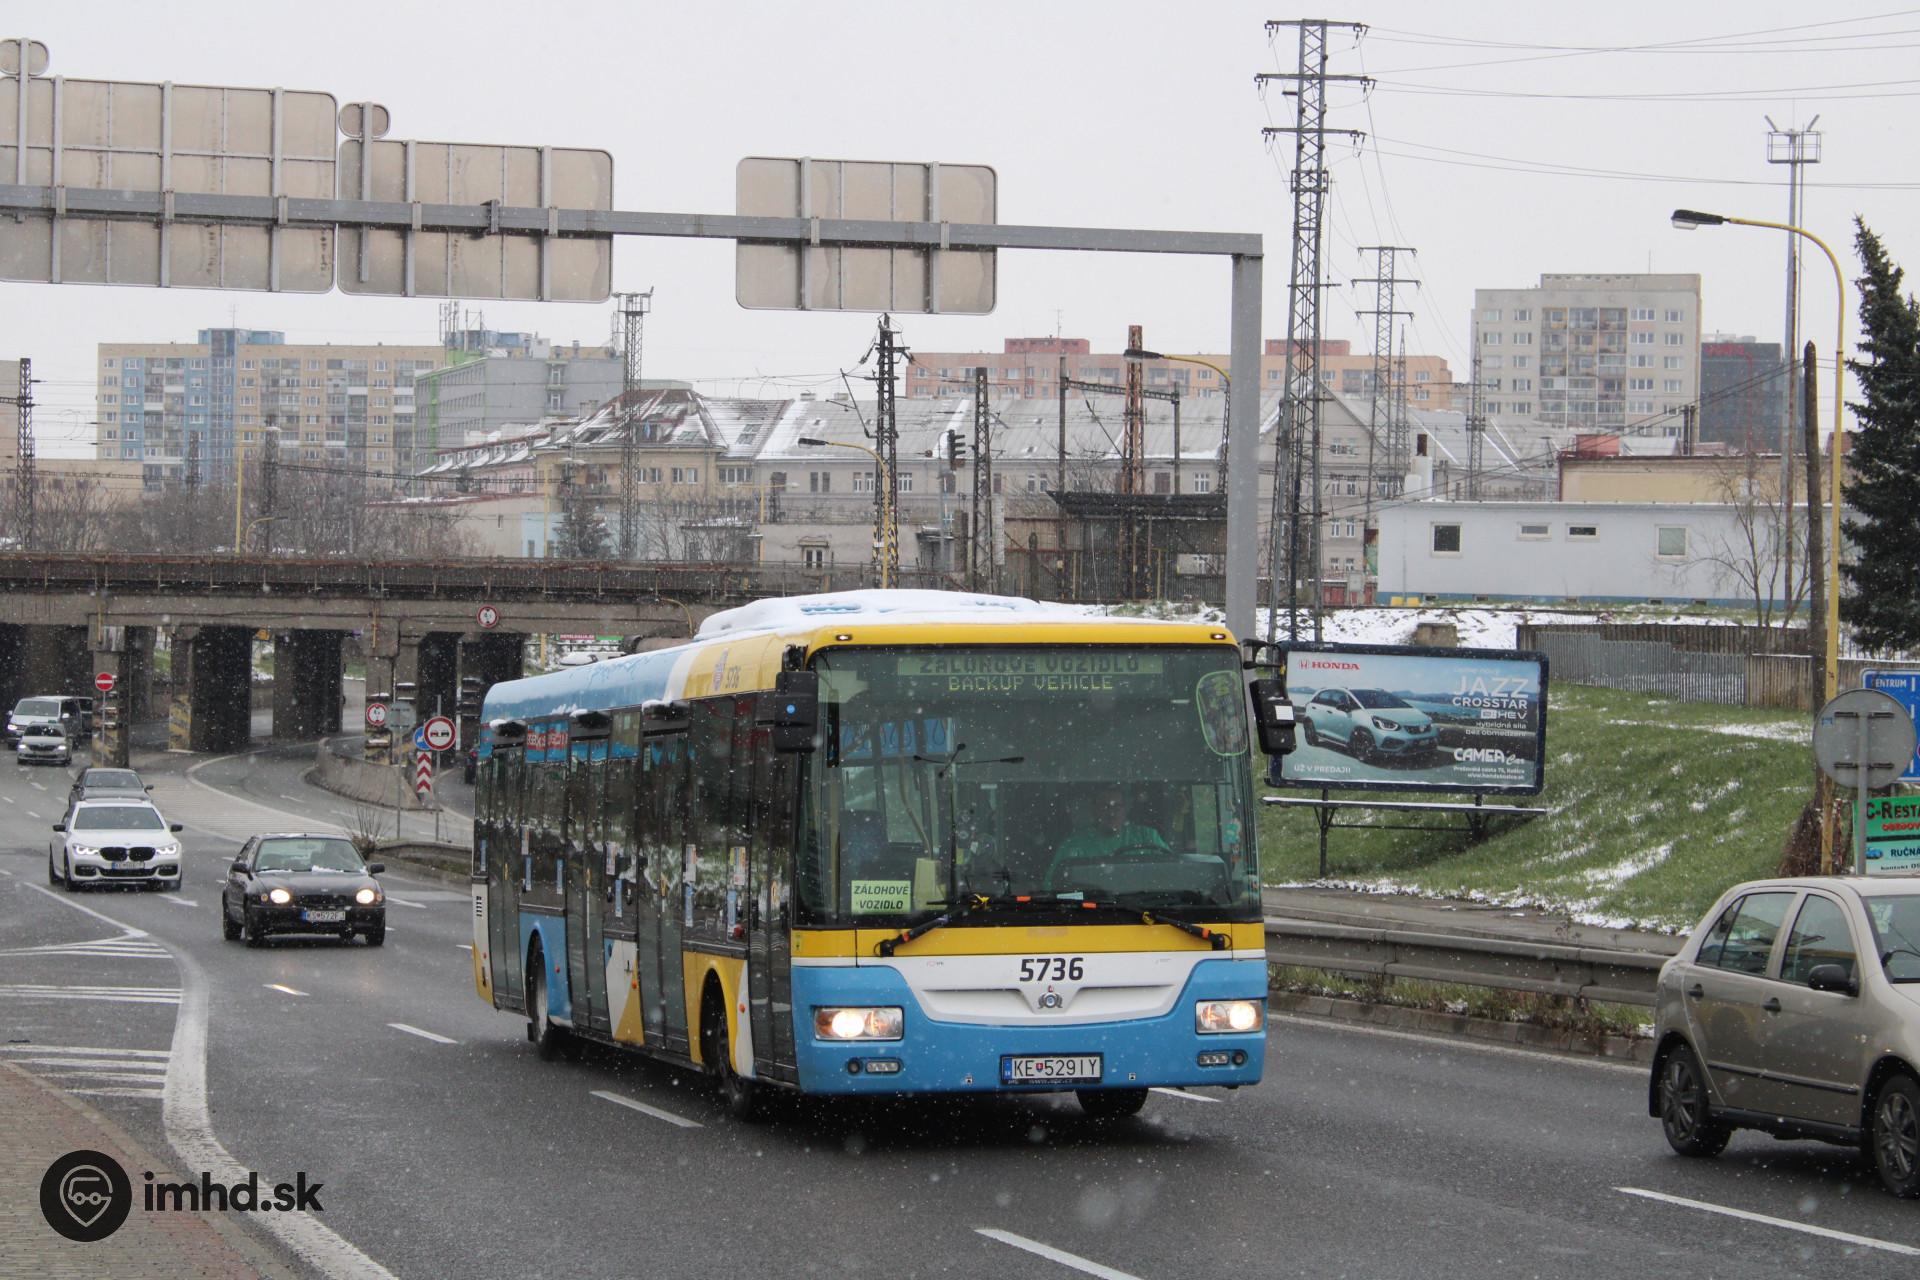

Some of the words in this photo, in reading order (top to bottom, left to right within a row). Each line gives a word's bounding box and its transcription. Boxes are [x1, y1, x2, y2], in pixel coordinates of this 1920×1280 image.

[1046, 655, 1140, 674] VOZIDLO
[1311, 661, 1360, 670] HONDA
[949, 675, 1025, 691] BACKUP
[1033, 675, 1114, 690] VEHICLE
[1454, 675, 1529, 699] JAZZ
[1871, 678, 1907, 688] ENTRUM
[1452, 696, 1528, 710] CROSSTAR
[860, 901, 903, 909] VOZIDLO
[1019, 957, 1085, 982] 5736
